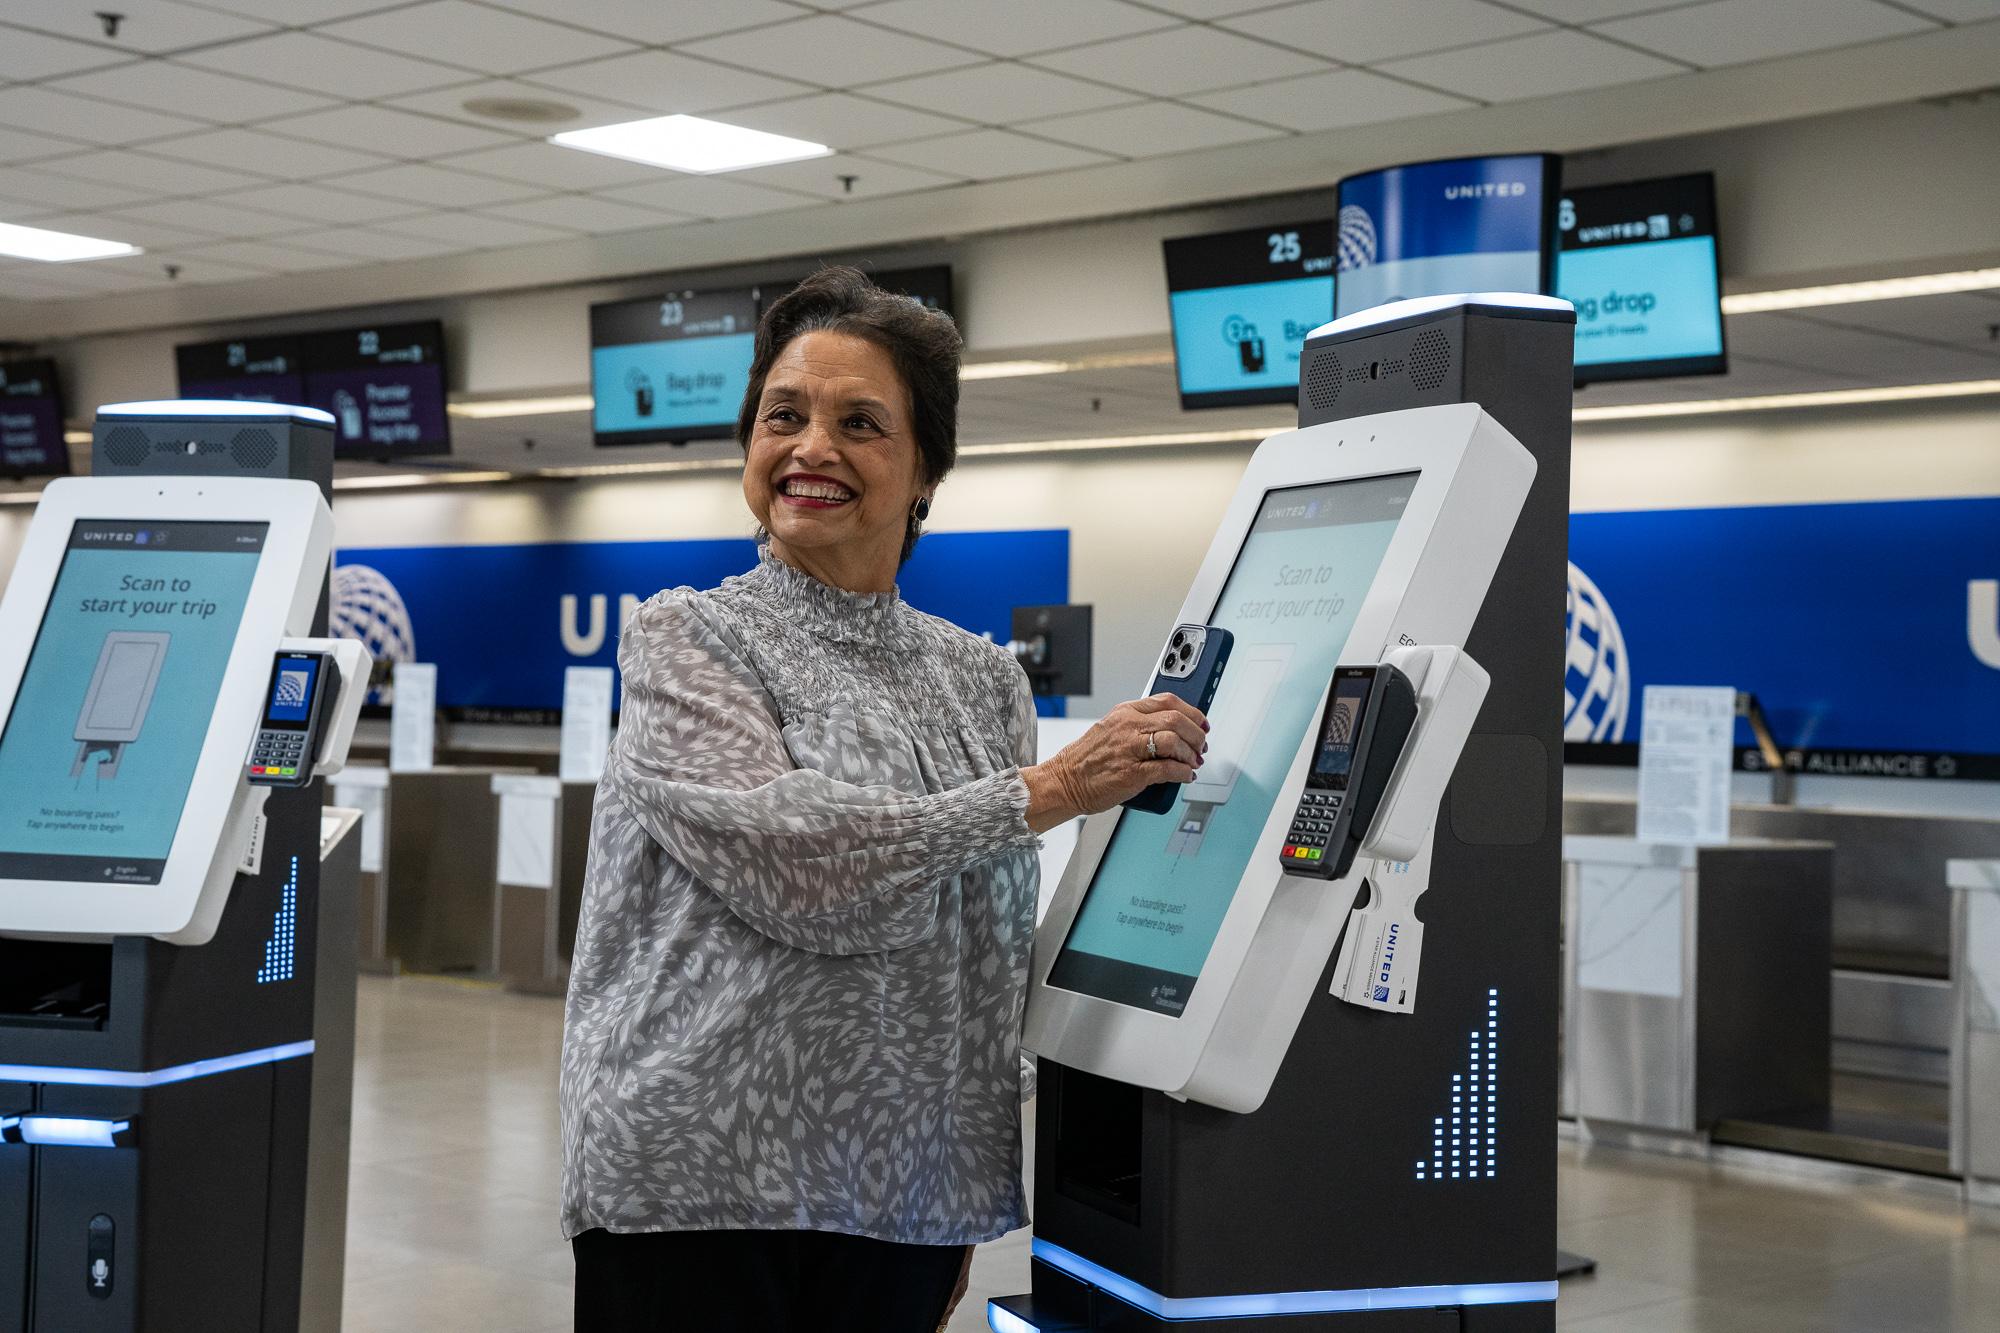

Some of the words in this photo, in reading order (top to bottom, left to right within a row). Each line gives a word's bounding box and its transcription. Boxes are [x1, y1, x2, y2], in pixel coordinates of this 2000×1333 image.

[1444, 182, 1526, 200] UNITED
[1578, 221, 1648, 242] UNITED
[1267, 231, 1302, 264] 25
[1602, 290, 1656, 314] drop
[1267, 506, 1305, 519] UNITED
[83, 532, 134, 542] UNITED
[120, 575, 165, 592] Scan
[171, 576, 191, 593] to
[1274, 564, 1311, 586] Scan
[1315, 565, 1333, 584] to
[80, 598, 126, 614] start
[129, 601, 177, 619] your
[182, 600, 217, 620] trip
[1236, 599, 1275, 620] start
[1270, 600, 1314, 625] your
[1314, 592, 1344, 623] trip
[1398, 633, 1417, 647] EG
[40, 808, 53, 816] No
[54, 808, 93, 820] boarding
[27, 819, 43, 830] Tap
[44, 821, 87, 832] anywhere
[88, 822, 98, 831] to
[99, 823, 124, 834] begin
[1139, 896, 1168, 914] boarding
[1116, 911, 1127, 926] Tap
[1127, 915, 1158, 930] anywhere
[1157, 918, 1166, 929] to
[1165, 920, 1184, 936] begin
[1380, 923, 1399, 982] UNITED
